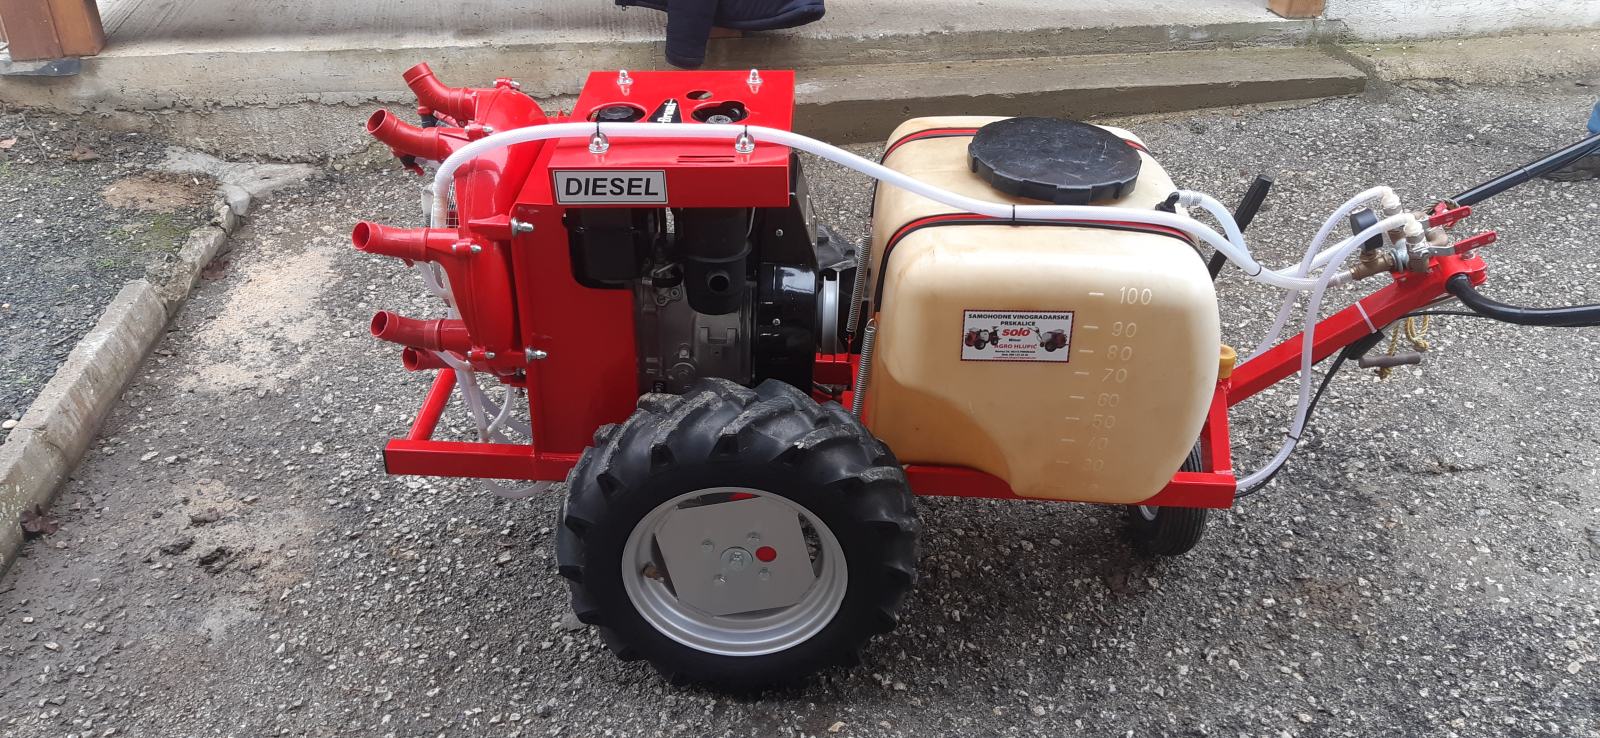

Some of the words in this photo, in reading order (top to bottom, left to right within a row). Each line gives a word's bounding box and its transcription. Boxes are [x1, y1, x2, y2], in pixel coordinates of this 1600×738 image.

[565, 177, 659, 196] DIESEL
[1120, 286, 1152, 305] 100
[1001, 327, 1031, 337] solo
[1112, 321, 1137, 338] 90
[1107, 344, 1132, 361] 80
[1102, 368, 1127, 383] 70
[1097, 392, 1120, 408] 60
[1092, 414, 1116, 429] 50
